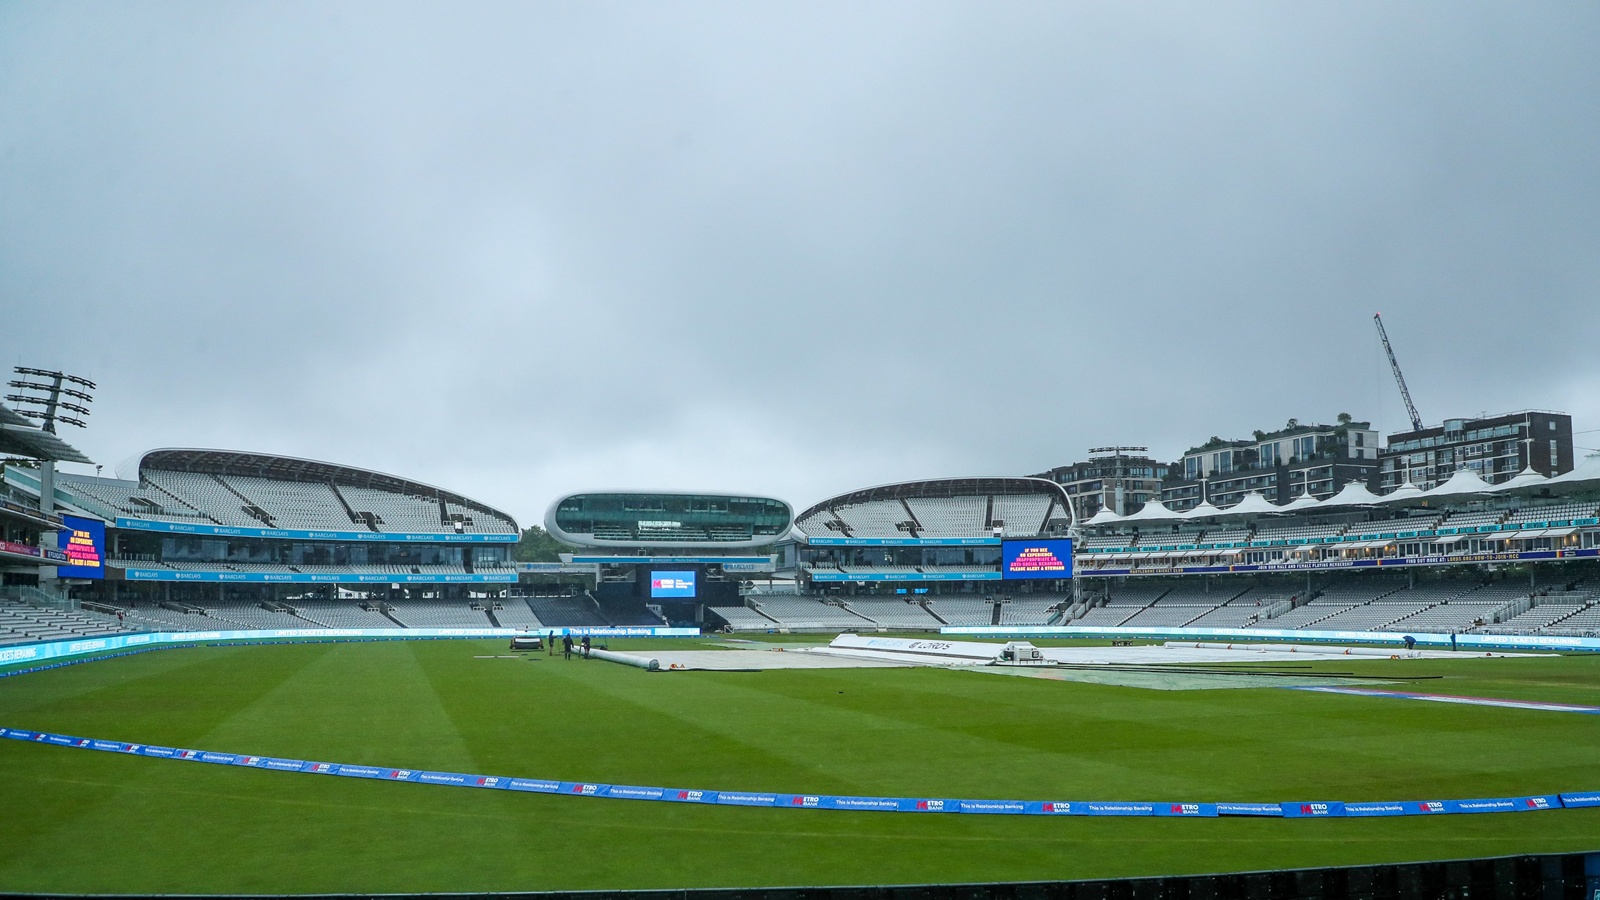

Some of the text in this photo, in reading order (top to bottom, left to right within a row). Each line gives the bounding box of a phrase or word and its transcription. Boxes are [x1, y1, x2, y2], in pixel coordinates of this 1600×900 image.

[573, 784, 597, 792] METRO
[677, 791, 702, 799] METRO
[792, 796, 819, 805] METRO
[917, 801, 944, 809] METRO
[1525, 798, 1546, 807] METRO
[1043, 803, 1070, 812] METRO
[1171, 804, 1199, 813] METRO
[1301, 804, 1327, 814] METRO
[1418, 802, 1442, 811] METRO
